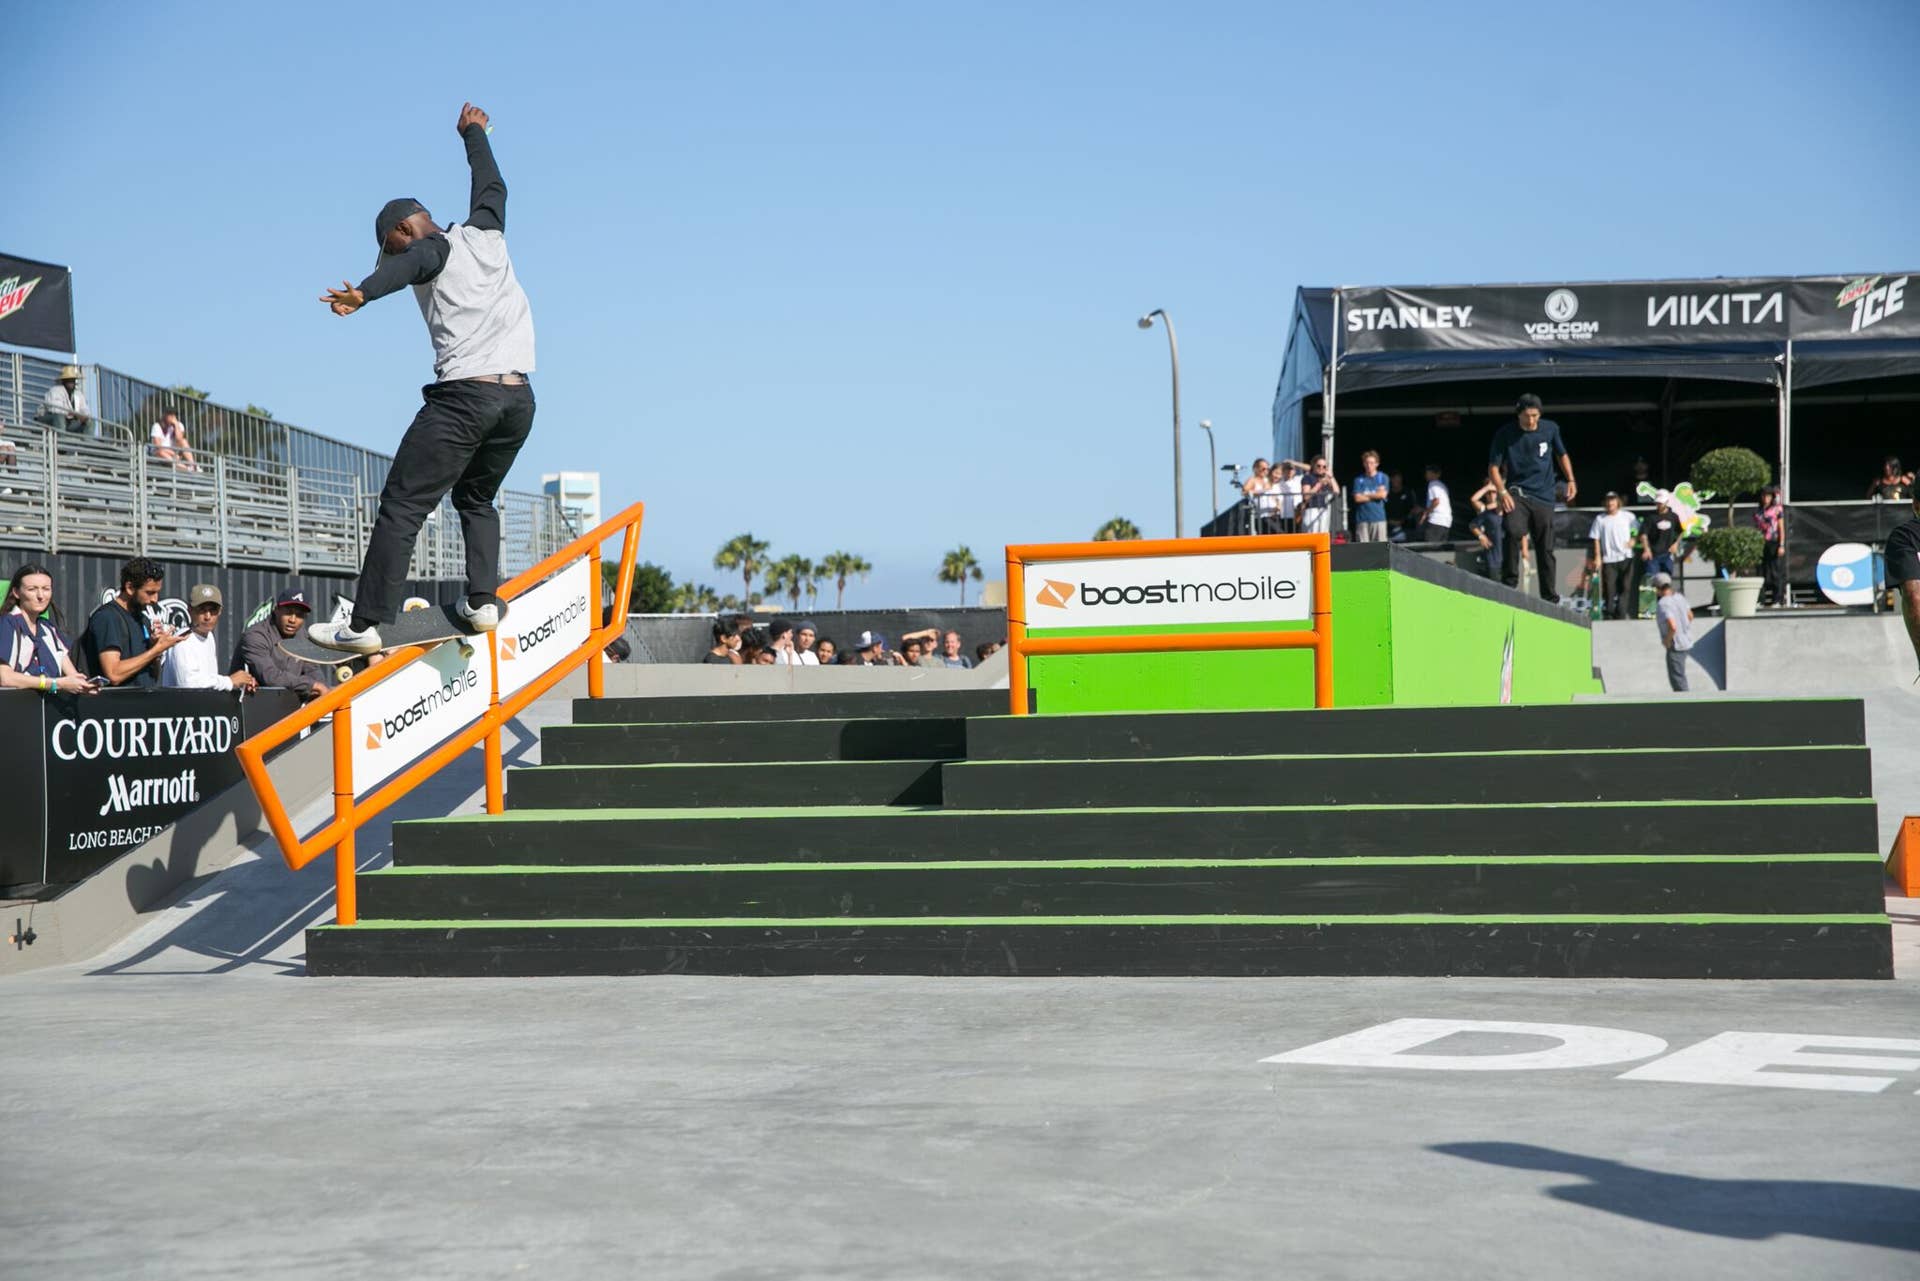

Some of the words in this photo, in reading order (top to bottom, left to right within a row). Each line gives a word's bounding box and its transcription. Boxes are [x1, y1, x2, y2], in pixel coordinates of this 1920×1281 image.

[1347, 306, 1473, 332] STANLEY
[1648, 292, 1784, 327] NIKITA
[1850, 275, 1908, 333] ICE
[1523, 321, 1599, 335] VOLCOM
[1081, 575, 1297, 606] boostmobile
[517, 595, 587, 653] boostmobile
[383, 669, 478, 740] boostmobile
[69, 830, 107, 850] LONG
[109, 826, 152, 847] BEACH
[1258, 1018, 1920, 1095] DE
